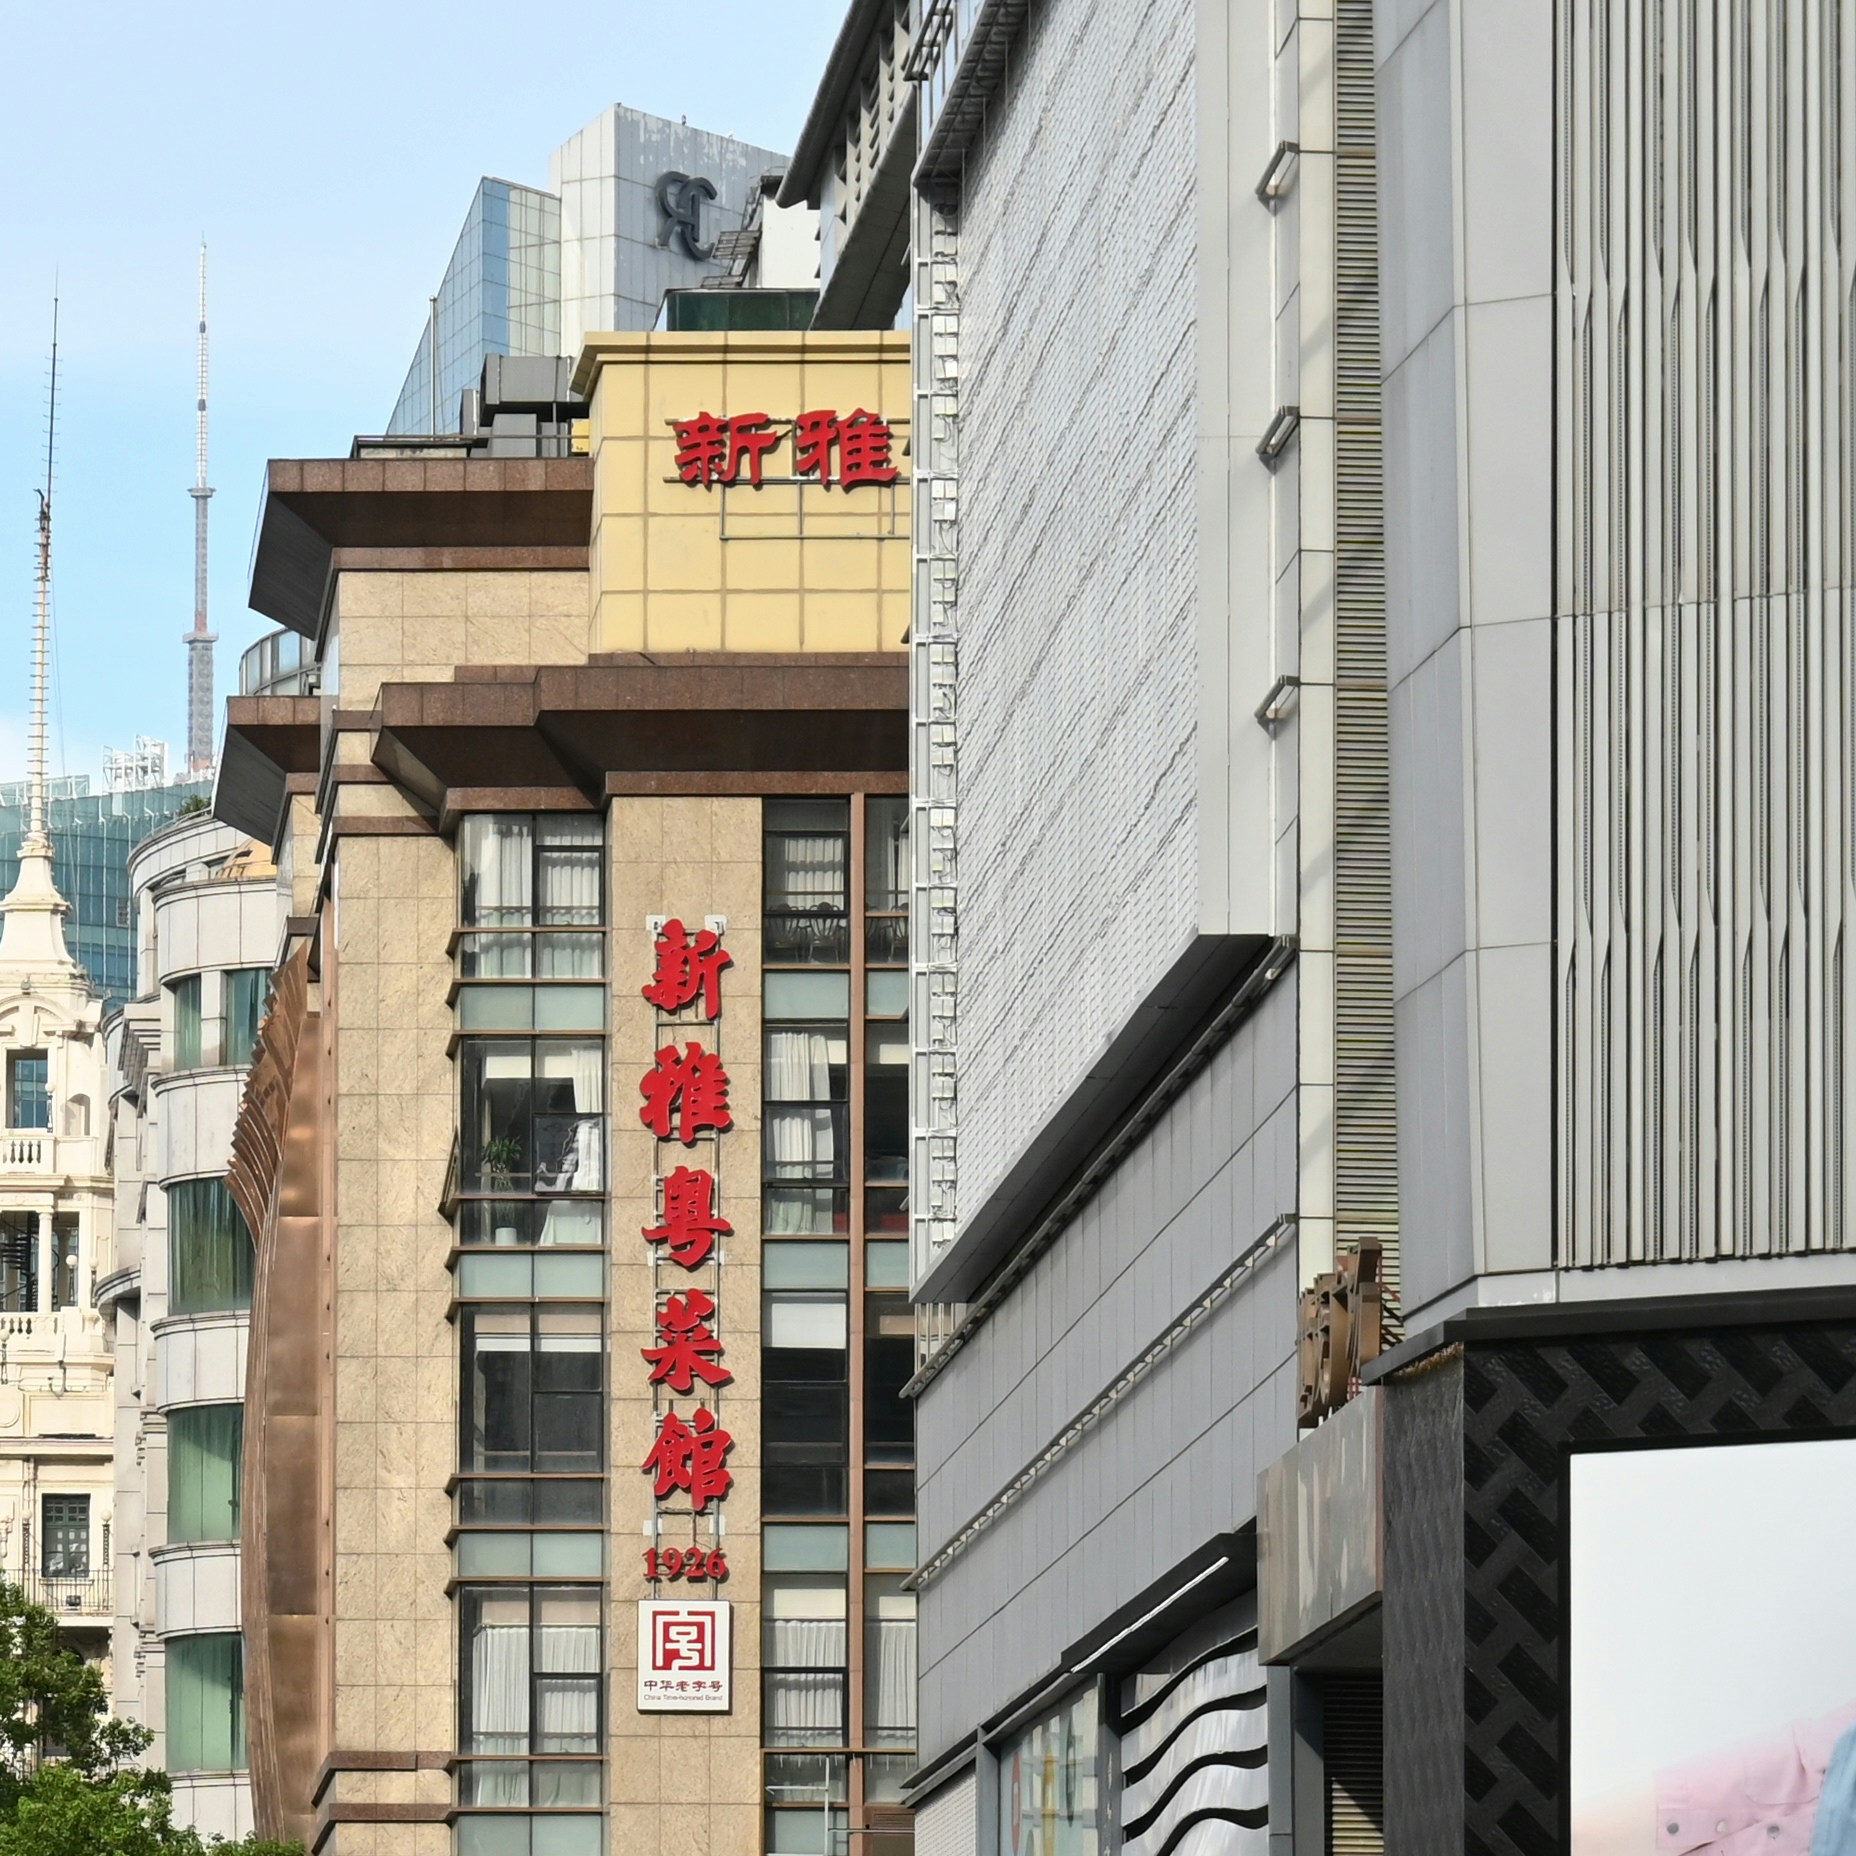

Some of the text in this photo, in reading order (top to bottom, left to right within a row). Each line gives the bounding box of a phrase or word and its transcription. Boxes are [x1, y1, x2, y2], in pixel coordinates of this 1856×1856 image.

[674, 408, 899, 489] 新雅
[642, 1547, 728, 1581] 1926
[644, 1680, 723, 1693] 中华老字号
